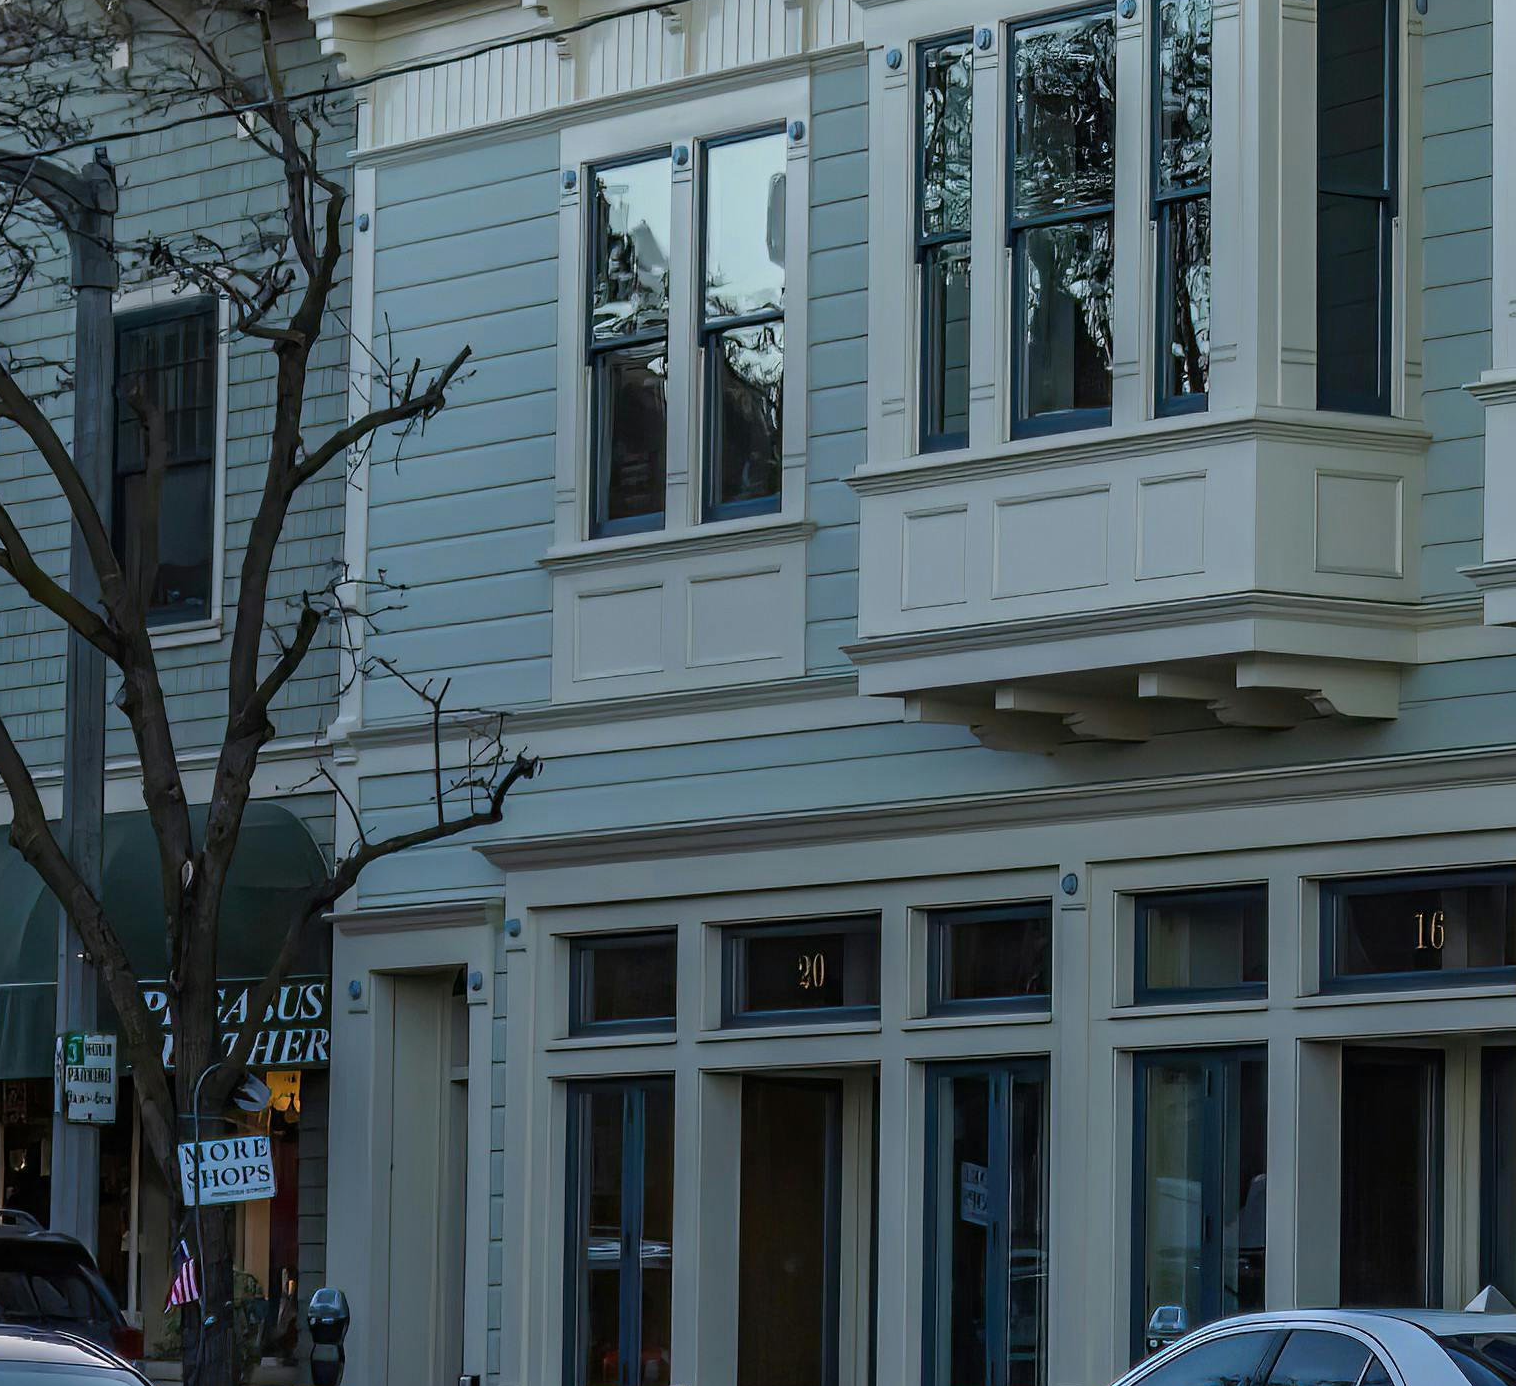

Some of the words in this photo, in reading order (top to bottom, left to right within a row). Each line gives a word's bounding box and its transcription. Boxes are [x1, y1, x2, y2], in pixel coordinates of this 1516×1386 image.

[1415, 911, 1444, 949] 16
[798, 953, 825, 989] 20
[185, 1138, 269, 1164] MORE
[187, 1165, 270, 1190] SHOPS
